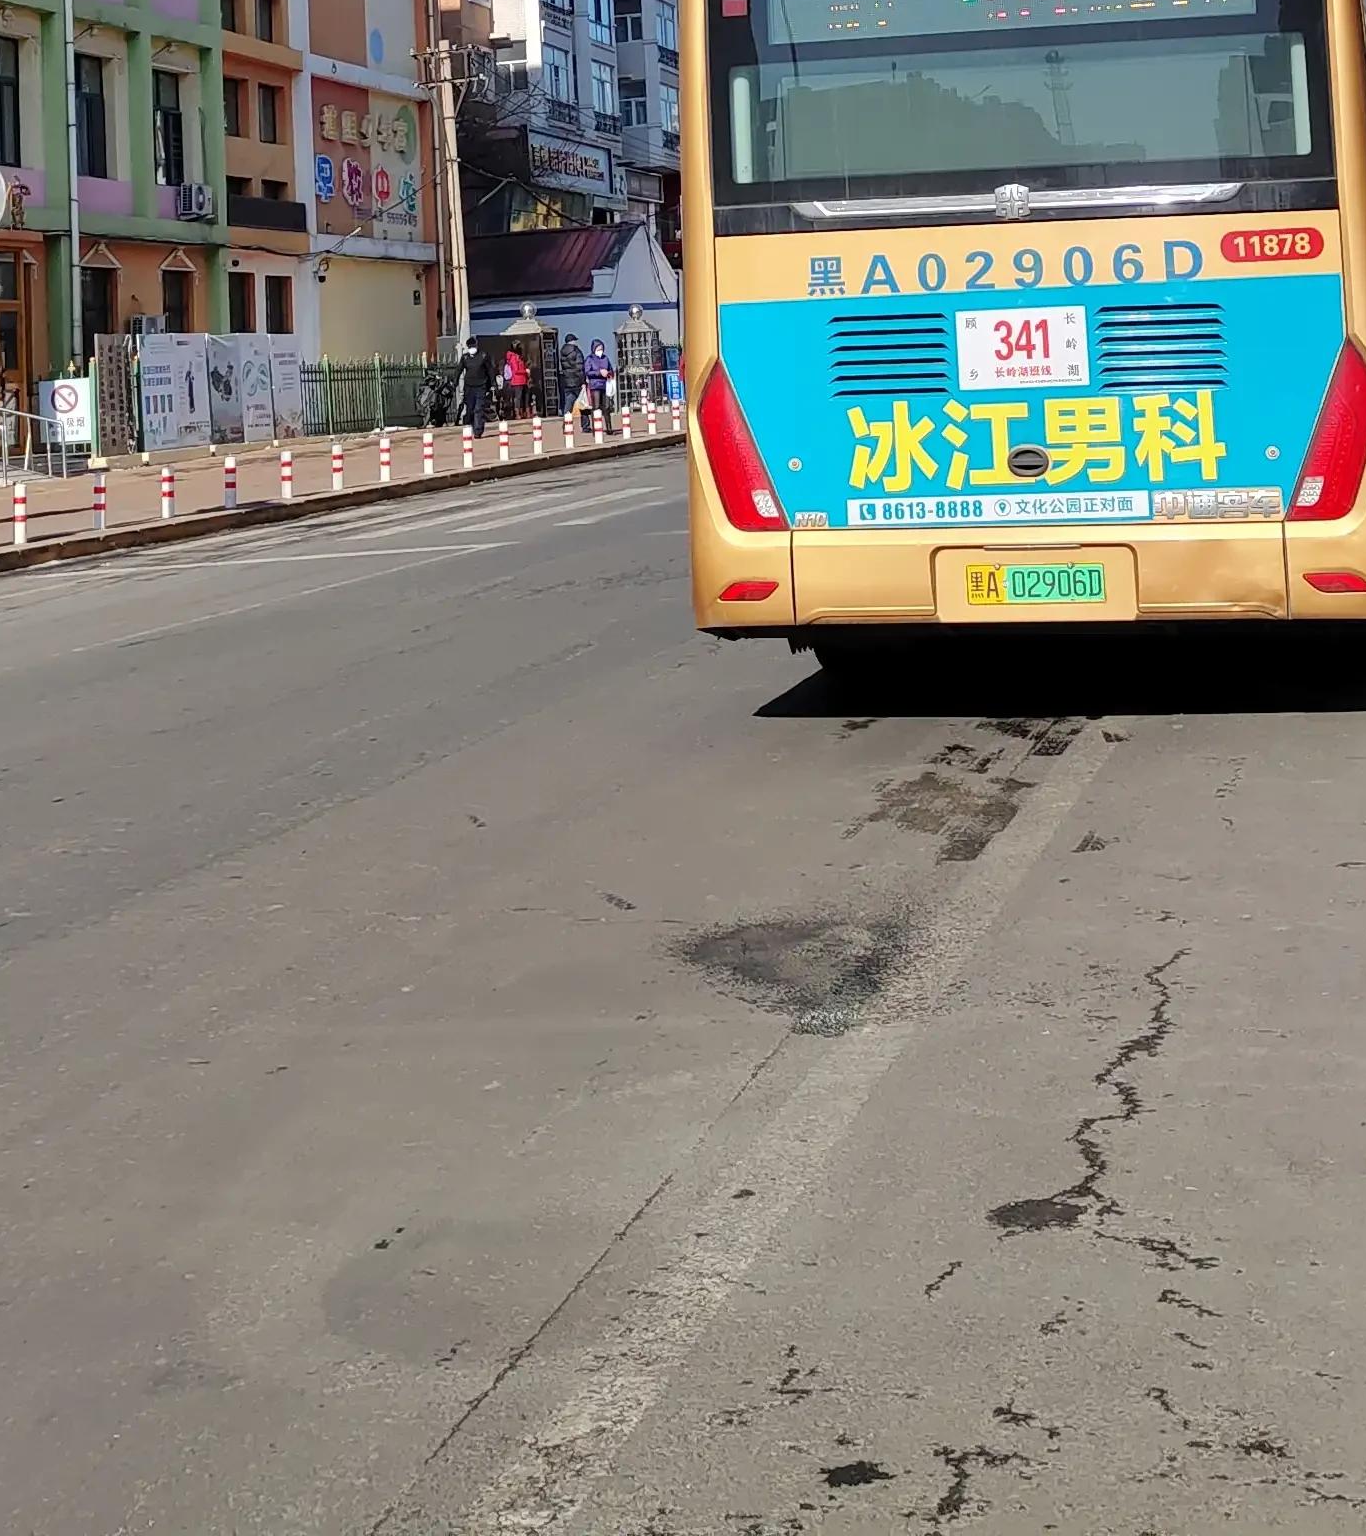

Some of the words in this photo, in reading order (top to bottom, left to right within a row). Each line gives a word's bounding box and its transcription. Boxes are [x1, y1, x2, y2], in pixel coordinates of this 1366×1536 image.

[1232, 232, 1312, 258] 11878
[806, 239, 1205, 297] 黑A02906D
[993, 318, 1051, 361] 341
[994, 365, 1053, 378] 长岭湖班线
[846, 388, 1227, 494] 冰江男科
[881, 498, 984, 522] 8613-8888
[1013, 495, 1134, 516] 文化公园正对面
[1154, 489, 1281, 519] 中通客车
